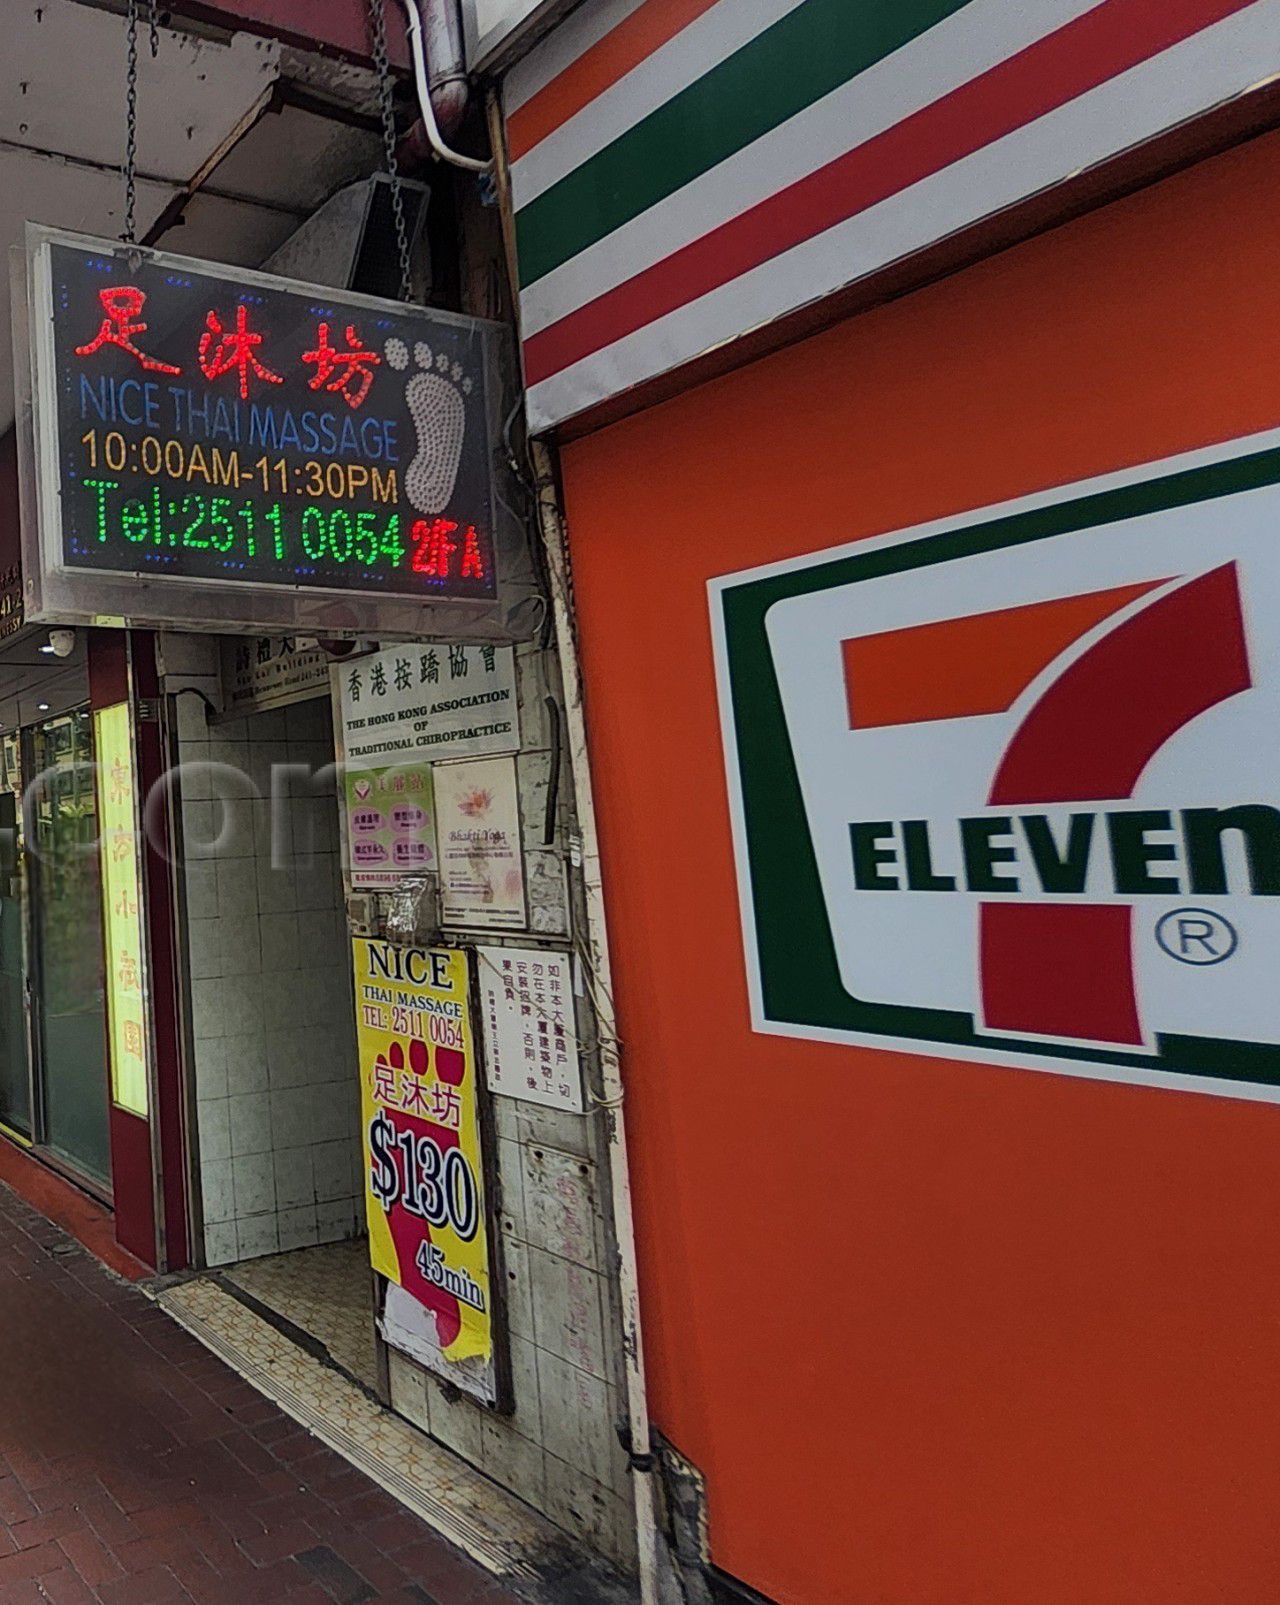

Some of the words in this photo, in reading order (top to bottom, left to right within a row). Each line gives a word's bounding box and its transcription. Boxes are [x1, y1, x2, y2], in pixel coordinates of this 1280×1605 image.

[74, 285, 382, 408] 足沐坊
[79, 374, 159, 424] NICE
[169, 386, 241, 443] THAI
[249, 405, 399, 462] MASSAGE
[82, 430, 400, 504] 10:00AM-11:30PM
[302, 506, 406, 568] 0054
[346, 720, 366, 731] THE
[367, 712, 395, 728] HONG
[398, 705, 428, 721] KONG
[430, 689, 510, 714] ASSOCIATION
[348, 738, 414, 757] TRADITIONAL
[416, 722, 512, 746] CHIROPRACTICE
[413, 721, 429, 732] OF
[840, 560, 1253, 1046] 7
[366, 944, 454, 989] NICE
[362, 984, 394, 1004] THAI
[397, 990, 464, 1020] MASSAGE
[362, 1004, 391, 1030] TEL:
[392, 1007, 424, 1039] 2511
[429, 1013, 465, 1049] 0054
[372, 1064, 464, 1128] 足沐坊
[368, 1111, 479, 1244] $130
[416, 1240, 486, 1311] 45min
